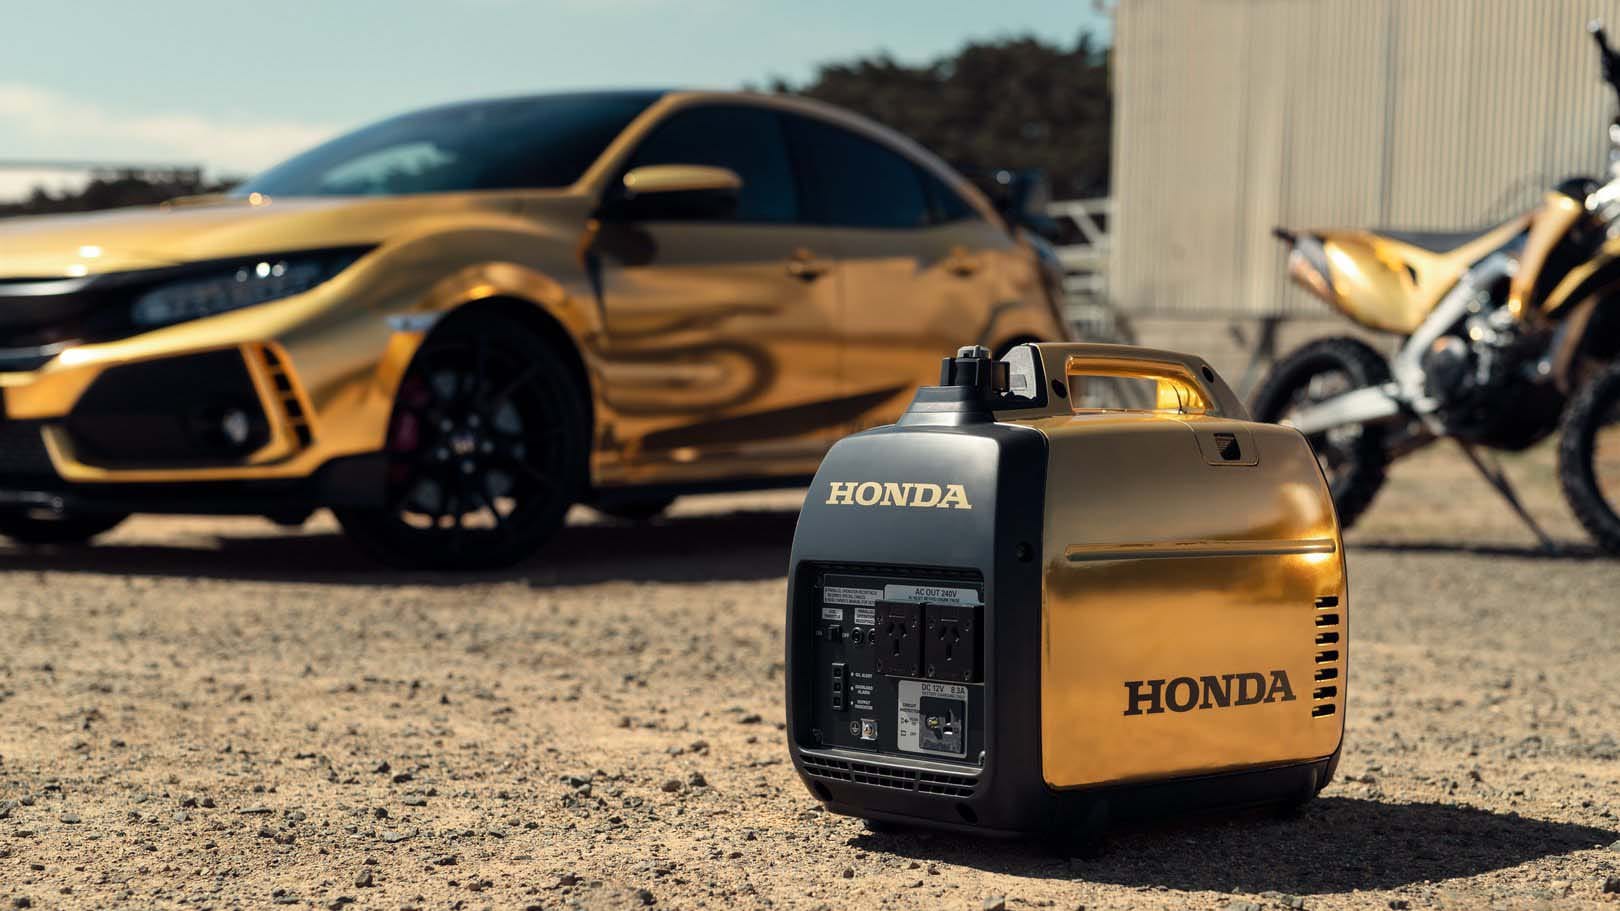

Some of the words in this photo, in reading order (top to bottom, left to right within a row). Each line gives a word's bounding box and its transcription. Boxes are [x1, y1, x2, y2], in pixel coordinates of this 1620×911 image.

[825, 481, 972, 509] HONDA
[915, 588, 925, 596] AC
[925, 588, 939, 597] OUT
[941, 589, 957, 598] 240V
[921, 683, 931, 692] DC
[932, 684, 945, 692] 12V
[1123, 670, 1297, 716] HONDA
